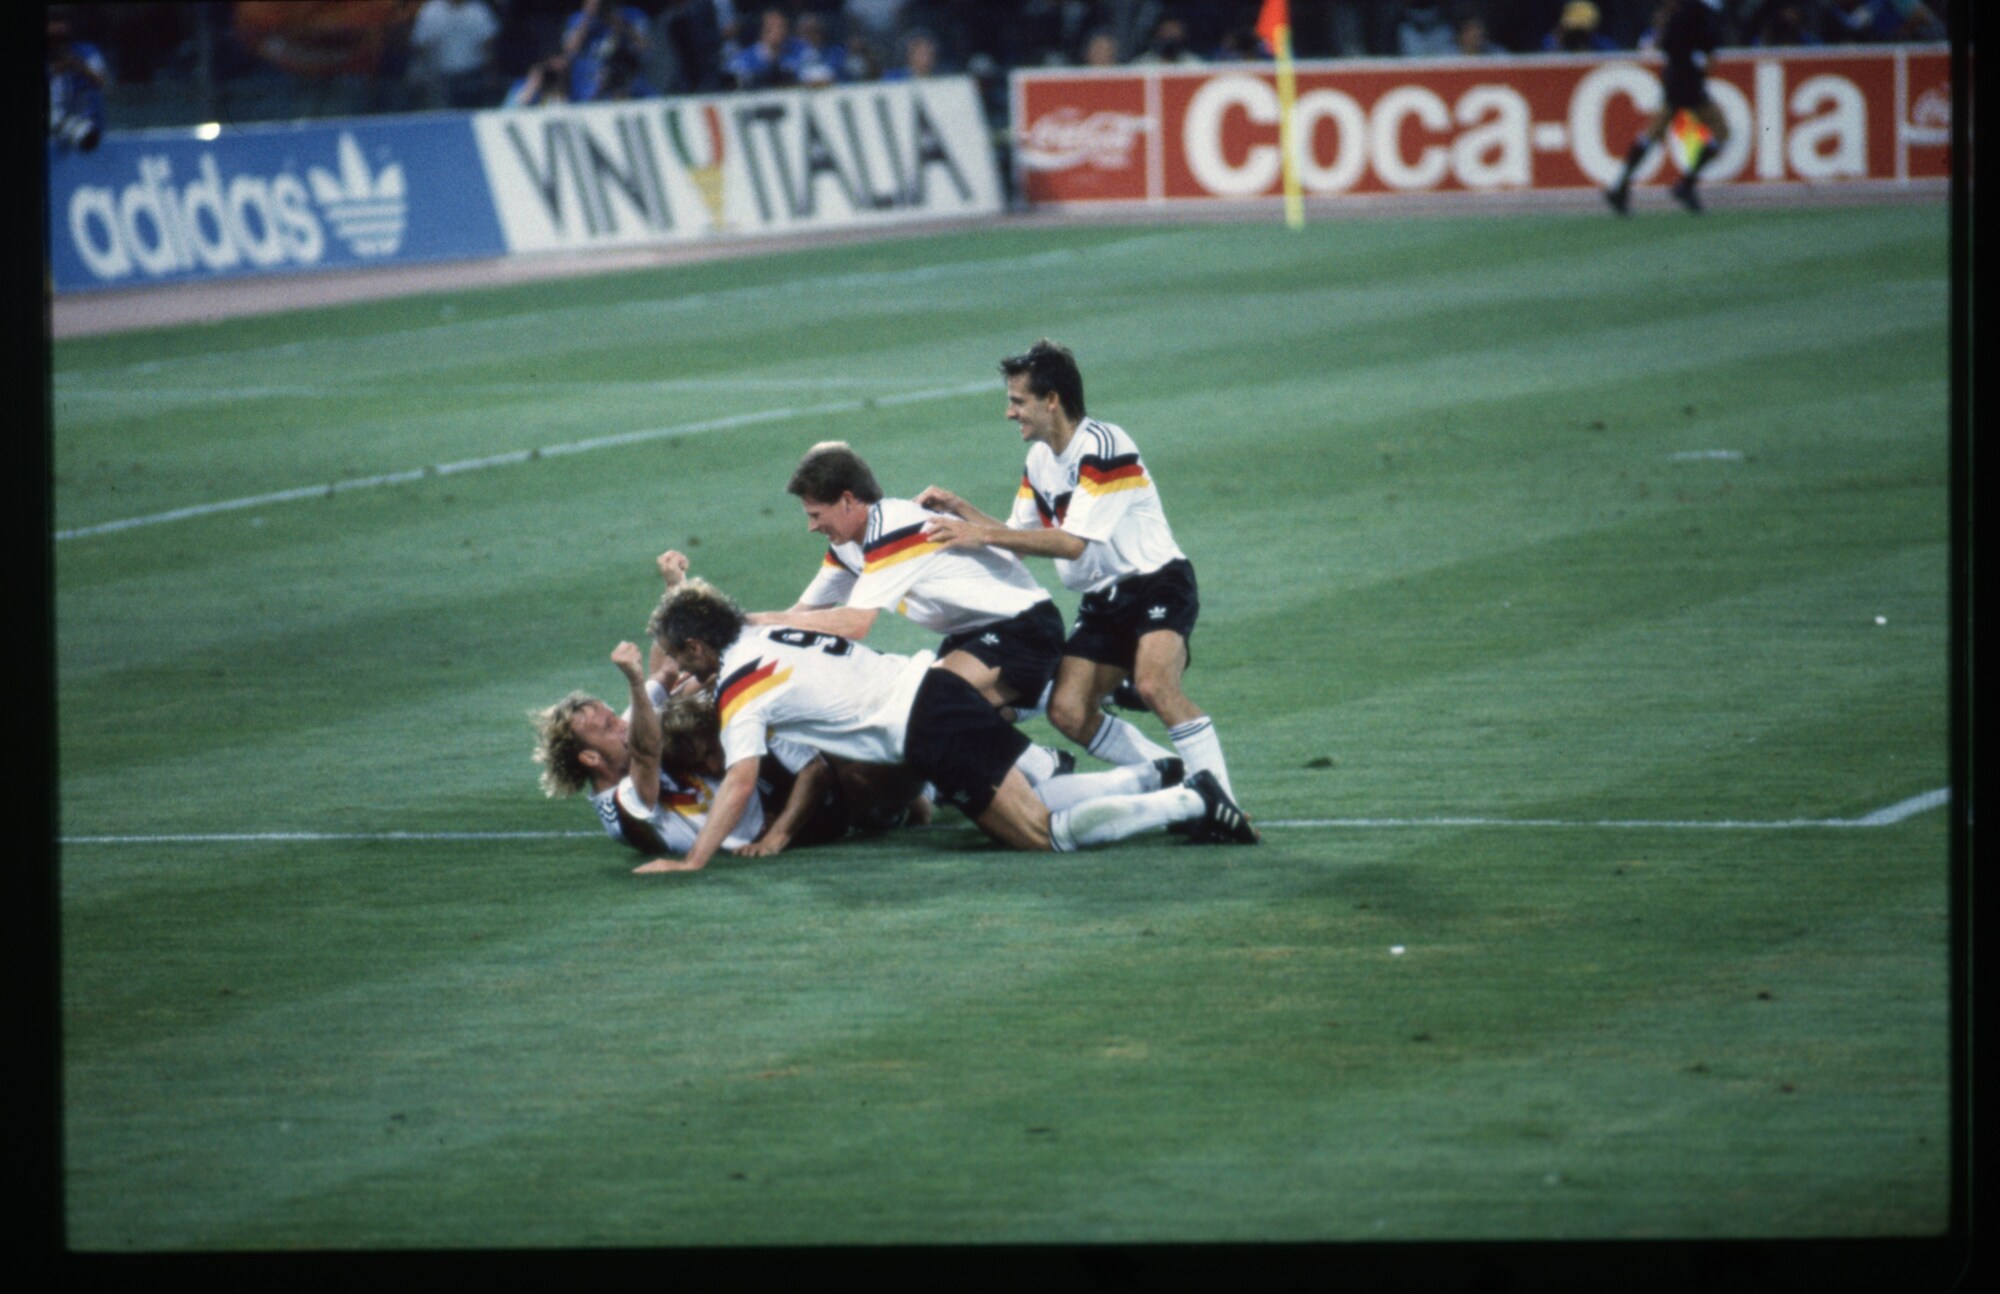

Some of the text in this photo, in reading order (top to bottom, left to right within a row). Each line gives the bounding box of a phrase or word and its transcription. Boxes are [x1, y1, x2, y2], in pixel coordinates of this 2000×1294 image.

[504, 112, 673, 237] VINI
[735, 92, 976, 223] ITALIA
[1183, 61, 1868, 196] Coca-Cola
[68, 153, 325, 279] adidas
[767, 627, 855, 657] 9
